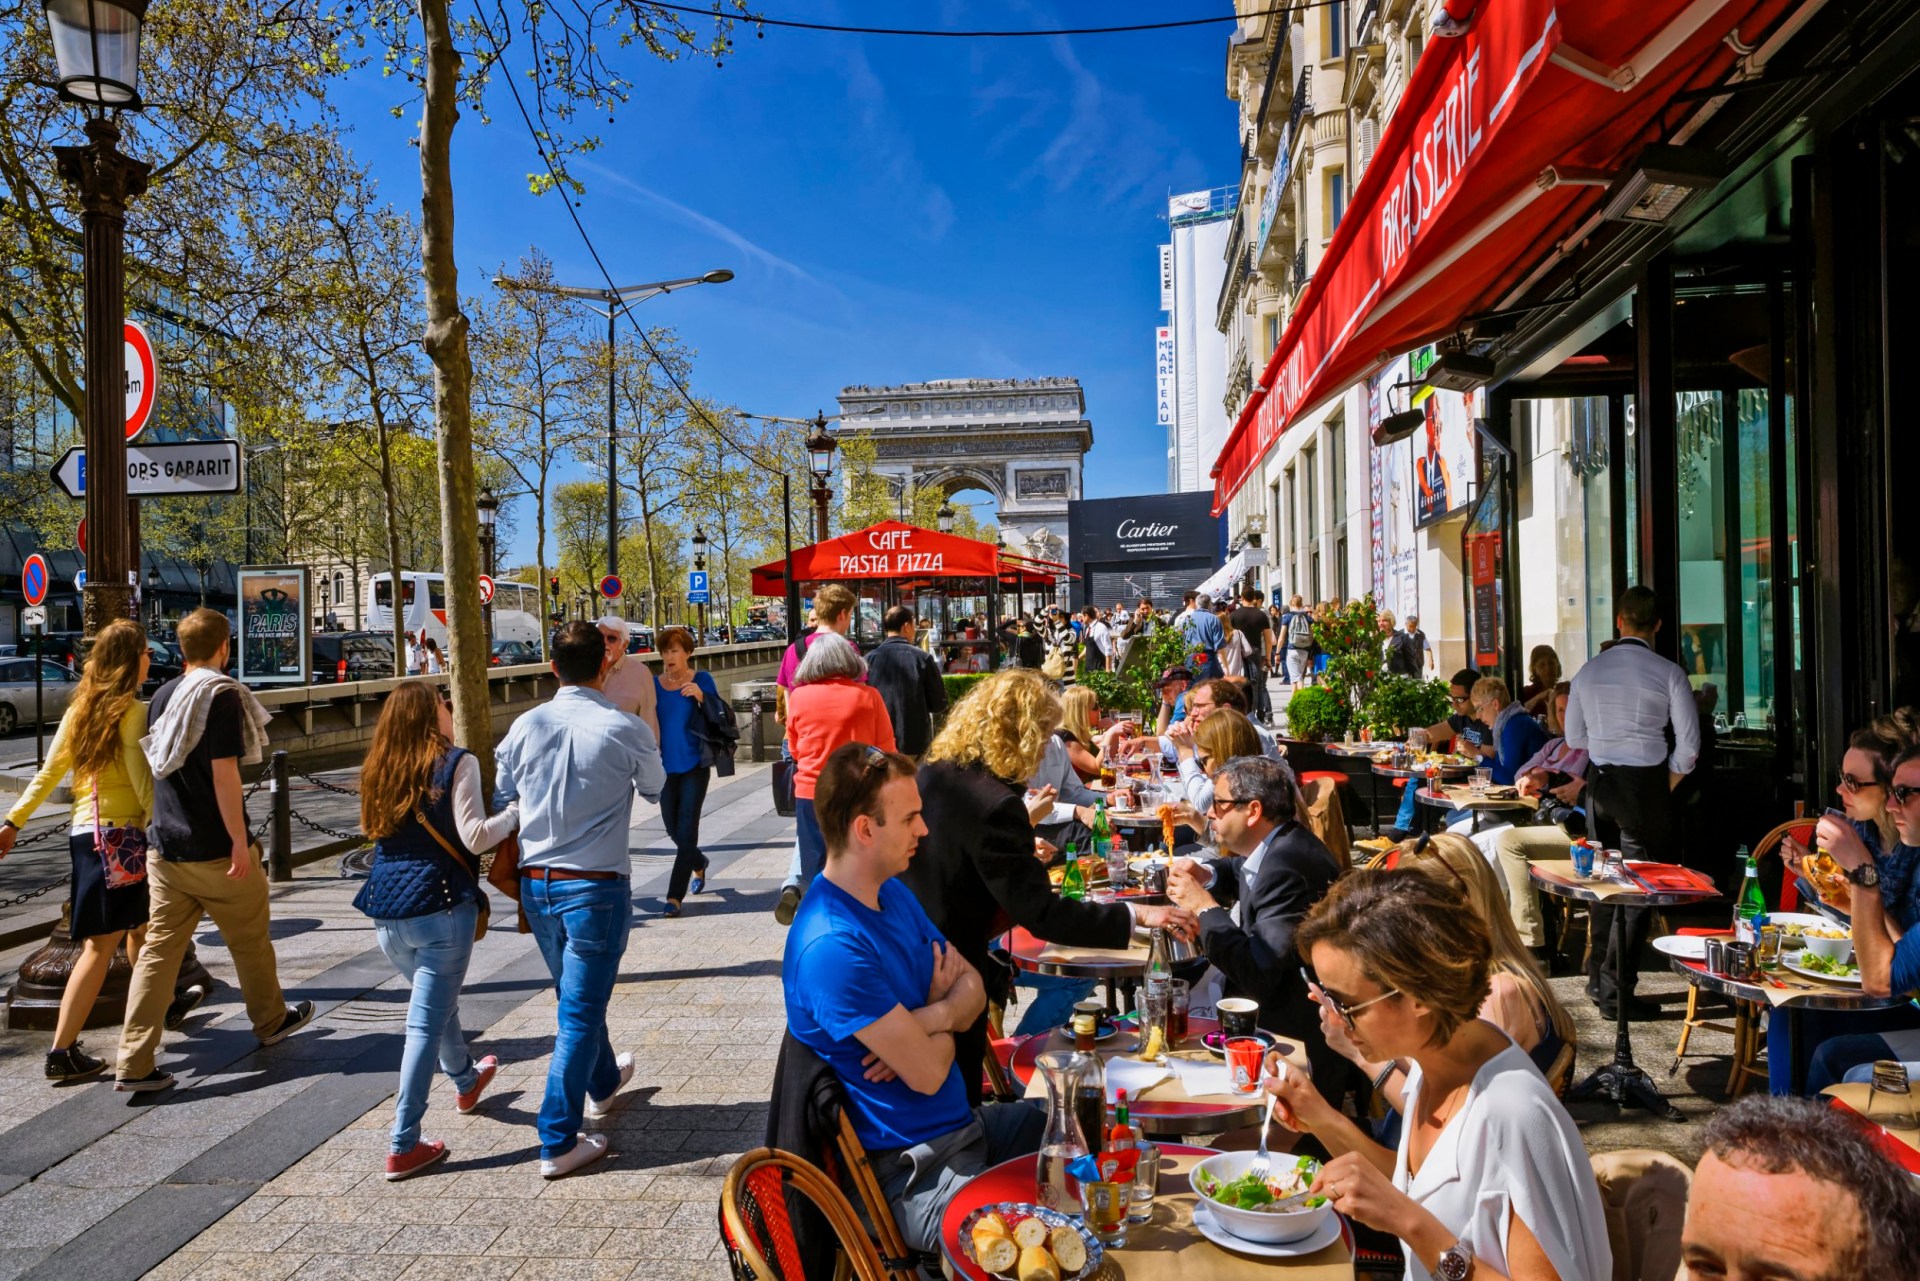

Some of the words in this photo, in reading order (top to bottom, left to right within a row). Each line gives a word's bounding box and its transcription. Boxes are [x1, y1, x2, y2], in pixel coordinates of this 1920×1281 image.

[1382, 44, 1482, 279] BRASSERIE
[1159, 341, 1169, 423] MARTEAU
[128, 461, 159, 479] ORS
[164, 458, 231, 476] GABARIT
[1116, 519, 1178, 539] Cartier
[868, 530, 912, 550] CAFE
[840, 554, 888, 574] PASTA
[897, 552, 943, 572] PIZZA
[694, 575, 703, 588] P
[248, 613, 297, 633] PARIS
